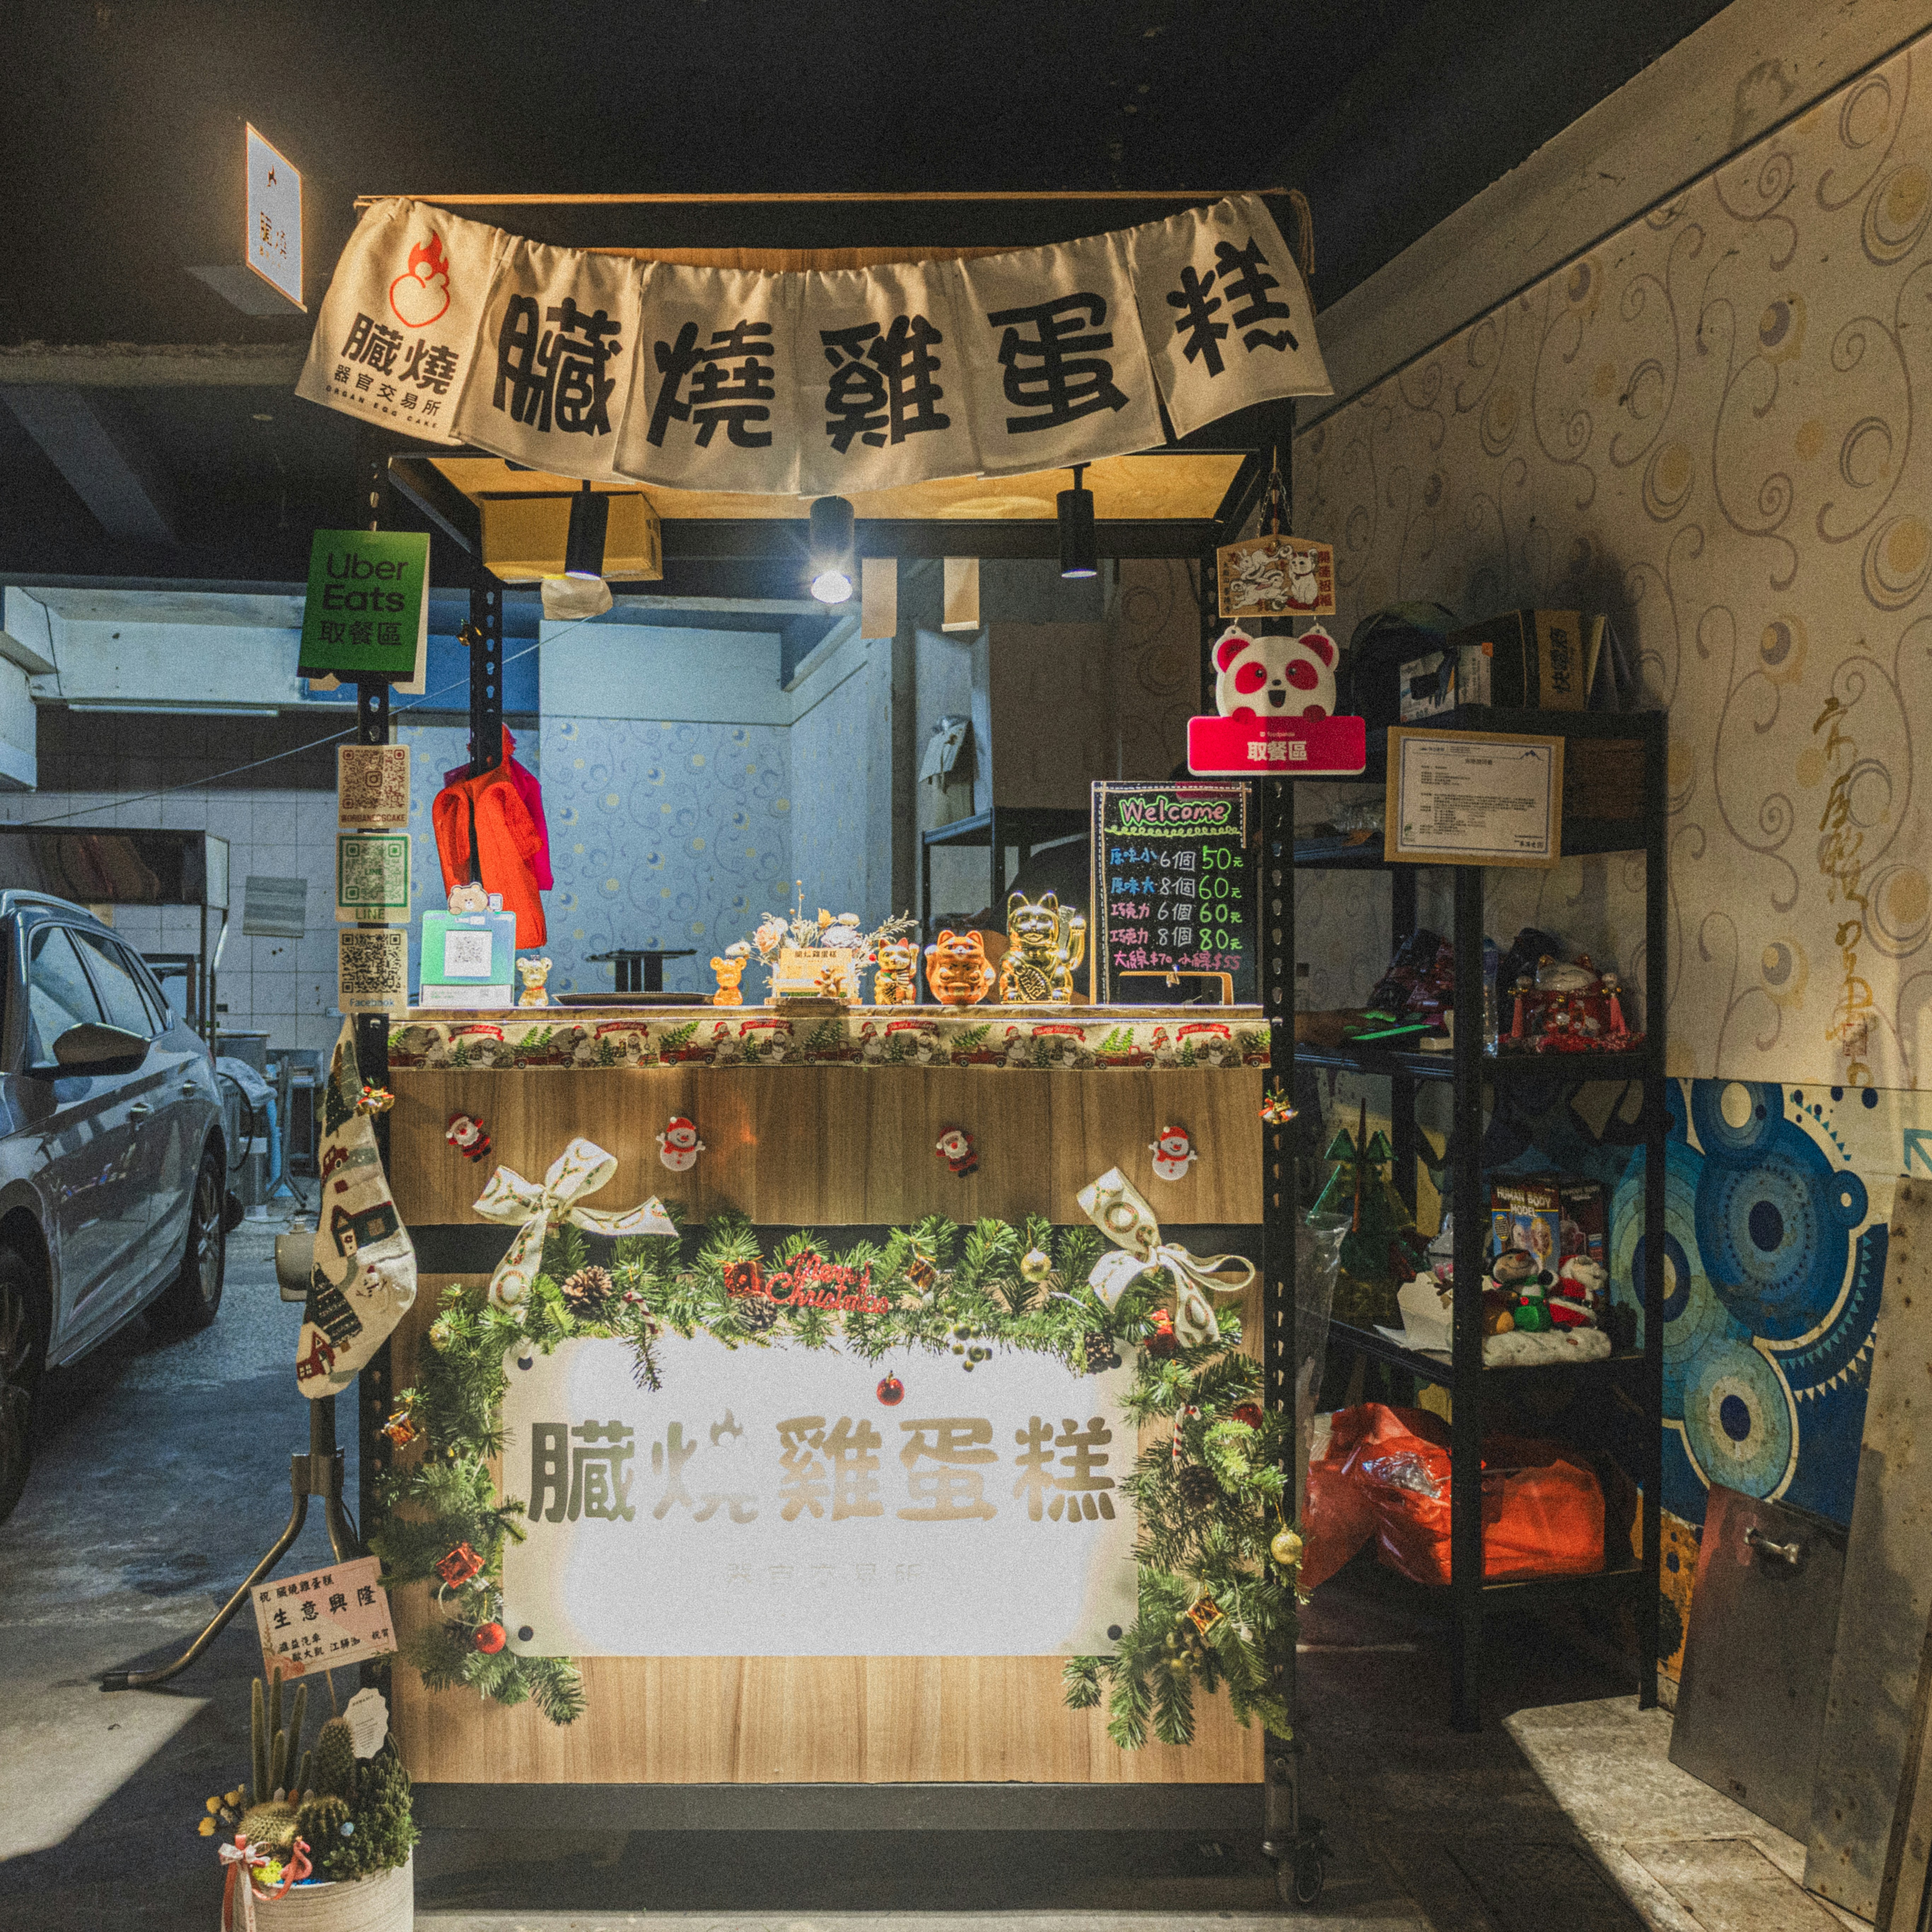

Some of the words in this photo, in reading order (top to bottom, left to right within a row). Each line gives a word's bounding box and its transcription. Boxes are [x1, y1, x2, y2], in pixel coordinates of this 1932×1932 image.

[341, 312, 459, 395] 臟燒
[493, 236, 1298, 454] 臟燒雞蛋糕
[334, 364, 442, 417] 器官交易所
[326, 385, 365, 403] ORGAN
[373, 402, 398, 417] EGG
[407, 416, 437, 428] CAKE
[327, 553, 409, 580] Uber
[322, 584, 406, 612] Eats
[319, 620, 402, 646] 取餐區
[1247, 741, 1308, 762] 取餐區
[1121, 800, 1226, 822] Welcome
[1110, 847, 1158, 865] 原味小
[1160, 851, 1196, 872] 6個
[1202, 845, 1244, 870] 50元
[1111, 876, 1154, 894] 原味大
[1159, 877, 1196, 898] 8個
[1199, 875, 1242, 900] 60元
[355, 908, 385, 919] LINE
[1110, 901, 1150, 920] 巧克力
[1157, 902, 1193, 920] 6個
[1199, 902, 1243, 924] 60元
[1110, 927, 1149, 945] 巧克力
[1158, 926, 1192, 947] 8個
[1199, 928, 1243, 950] 80元
[1496, 1186, 1525, 1203] HUMAN
[1526, 1191, 1551, 1209] BODY
[1510, 1201, 1538, 1217] MODEL
[785, 1246, 870, 1297] Merry
[765, 1272, 889, 1314] Christmas
[259, 1591, 272, 1603] 祝
[273, 1585, 377, 1629] 生意興隆
